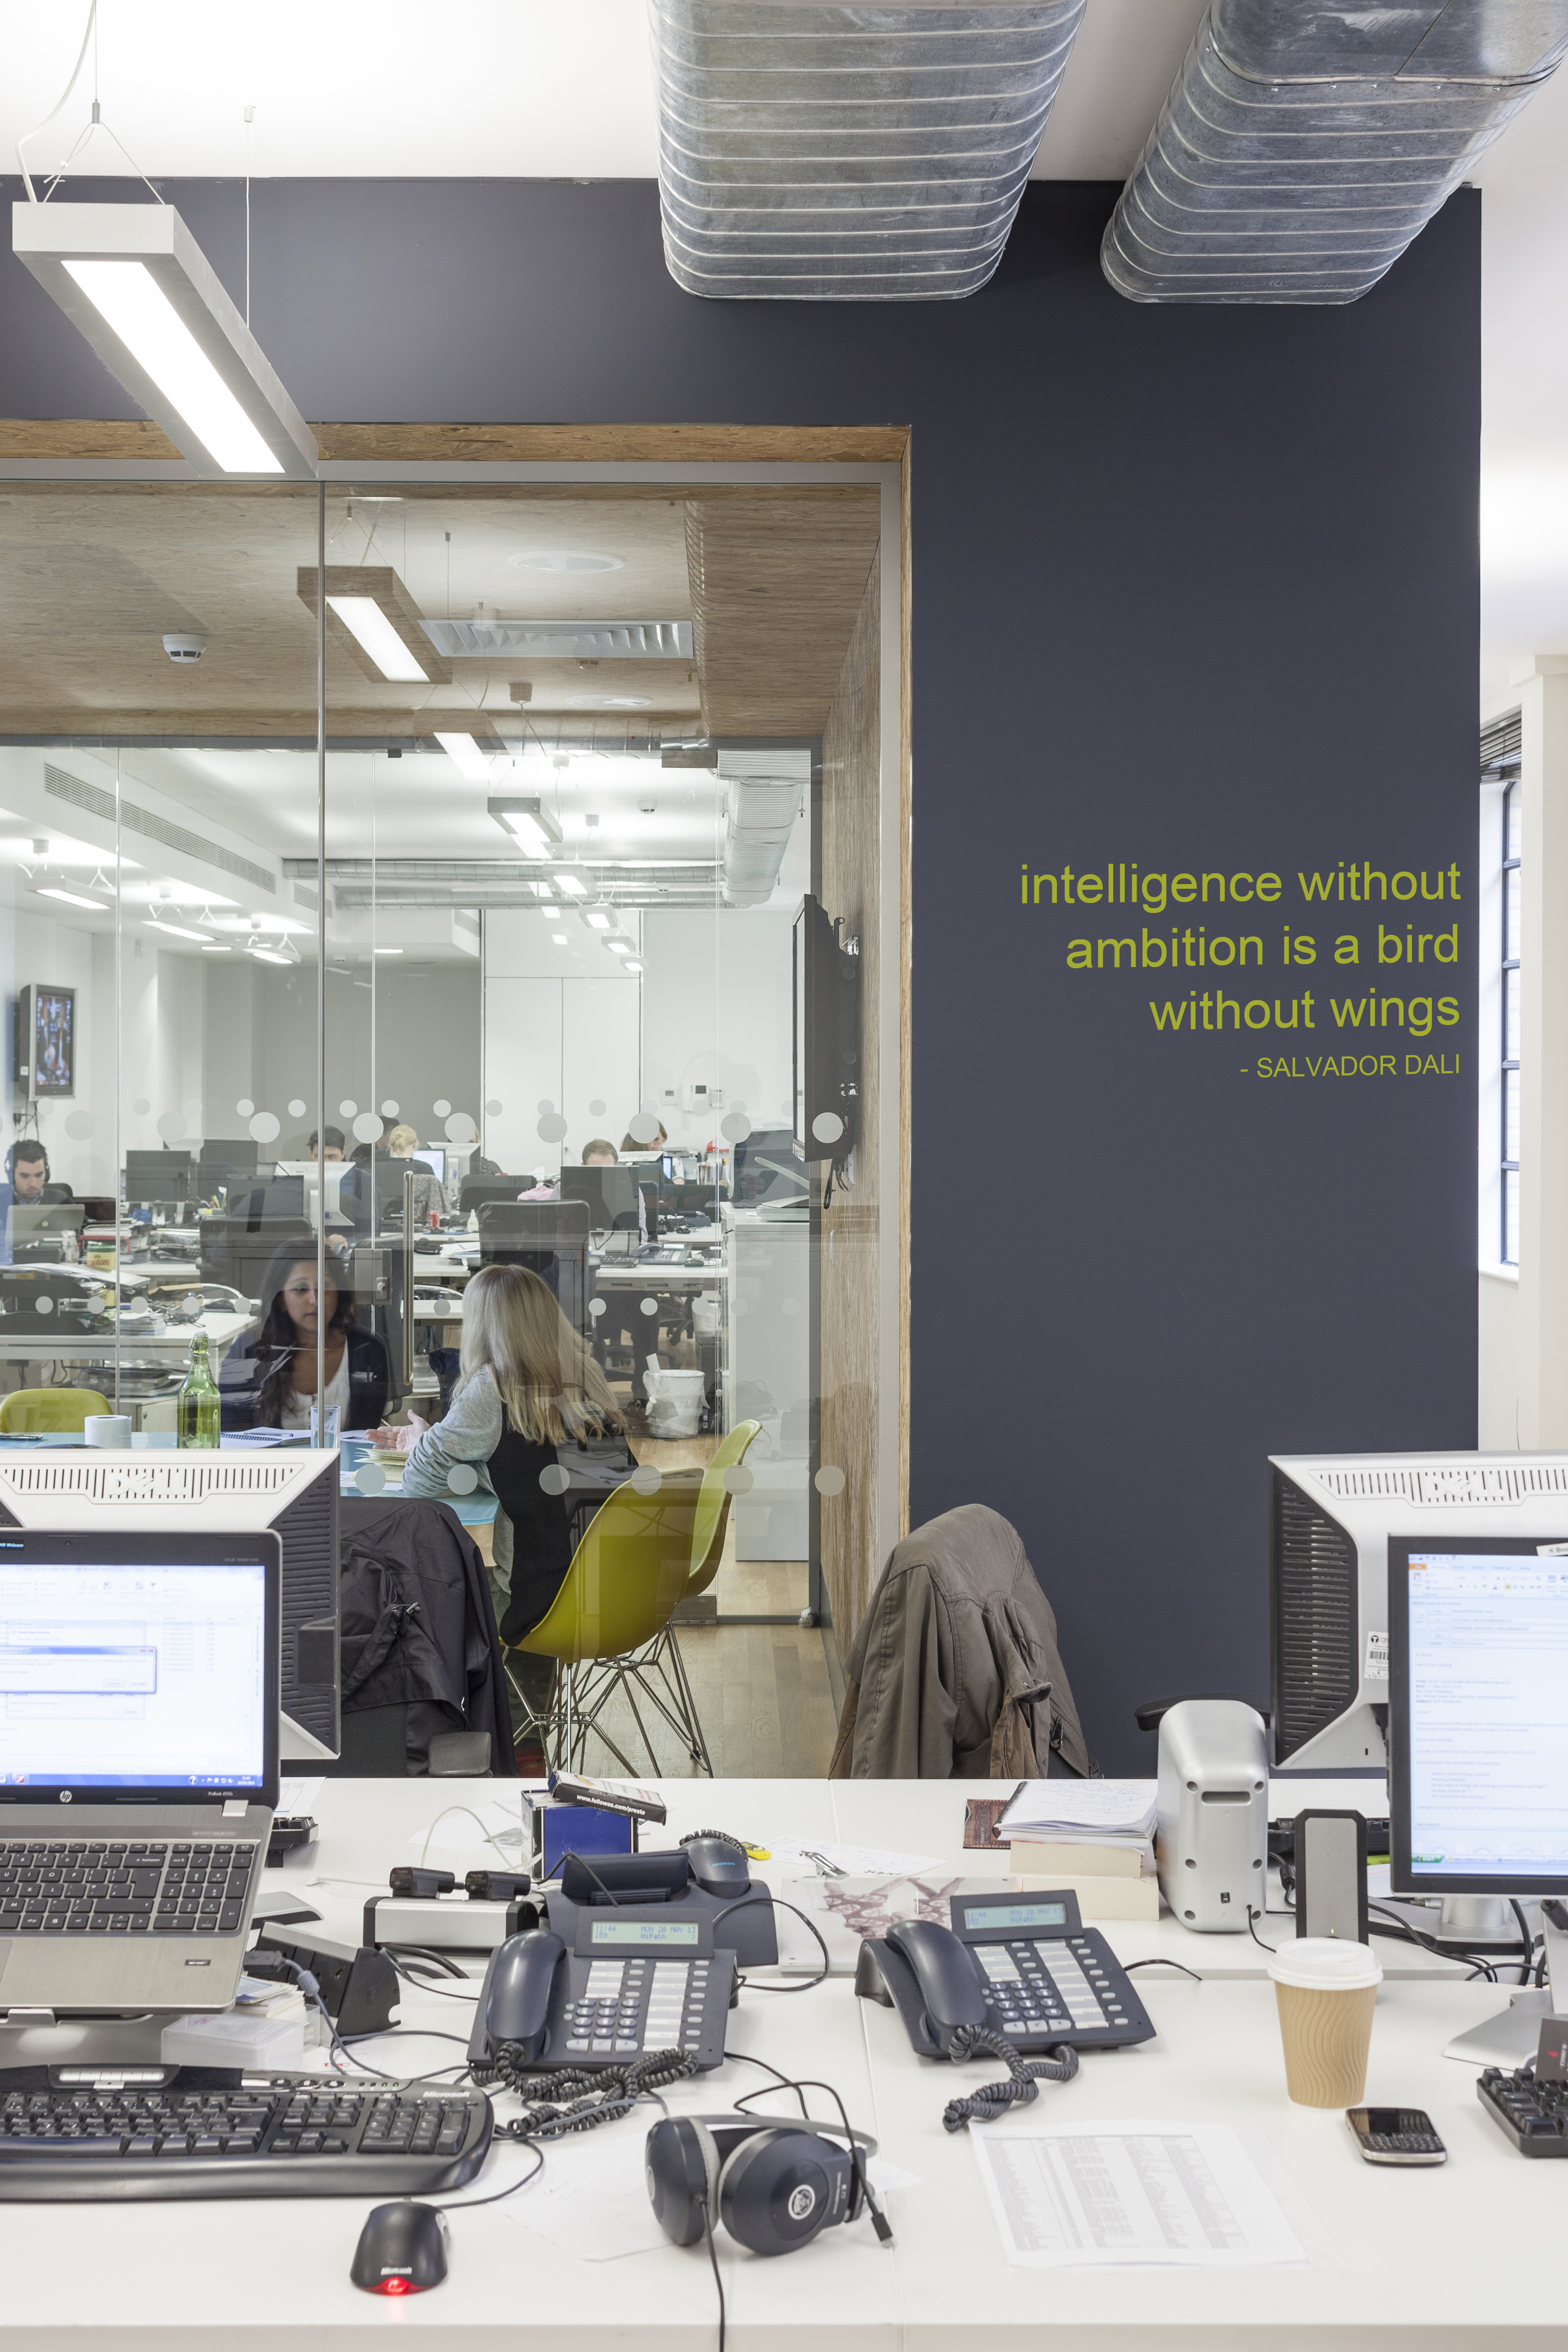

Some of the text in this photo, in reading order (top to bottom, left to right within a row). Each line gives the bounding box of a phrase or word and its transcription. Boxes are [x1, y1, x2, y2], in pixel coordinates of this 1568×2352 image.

[1022, 862, 1461, 913] intelligence without
[1067, 924, 1457, 968] ambition is a bird
[1149, 988, 1459, 1036] without wings
[1257, 1055, 1397, 1078] SALVADOR
[1406, 1054, 1459, 1074] DALI
[107, 1472, 188, 1496] DELL
[1424, 1474, 1506, 1498] DELL
[60, 1790, 72, 1803] hp
[576, 1794, 646, 1816] www.fellowes.com/presto
[380, 2266, 413, 2276] Microsoft
